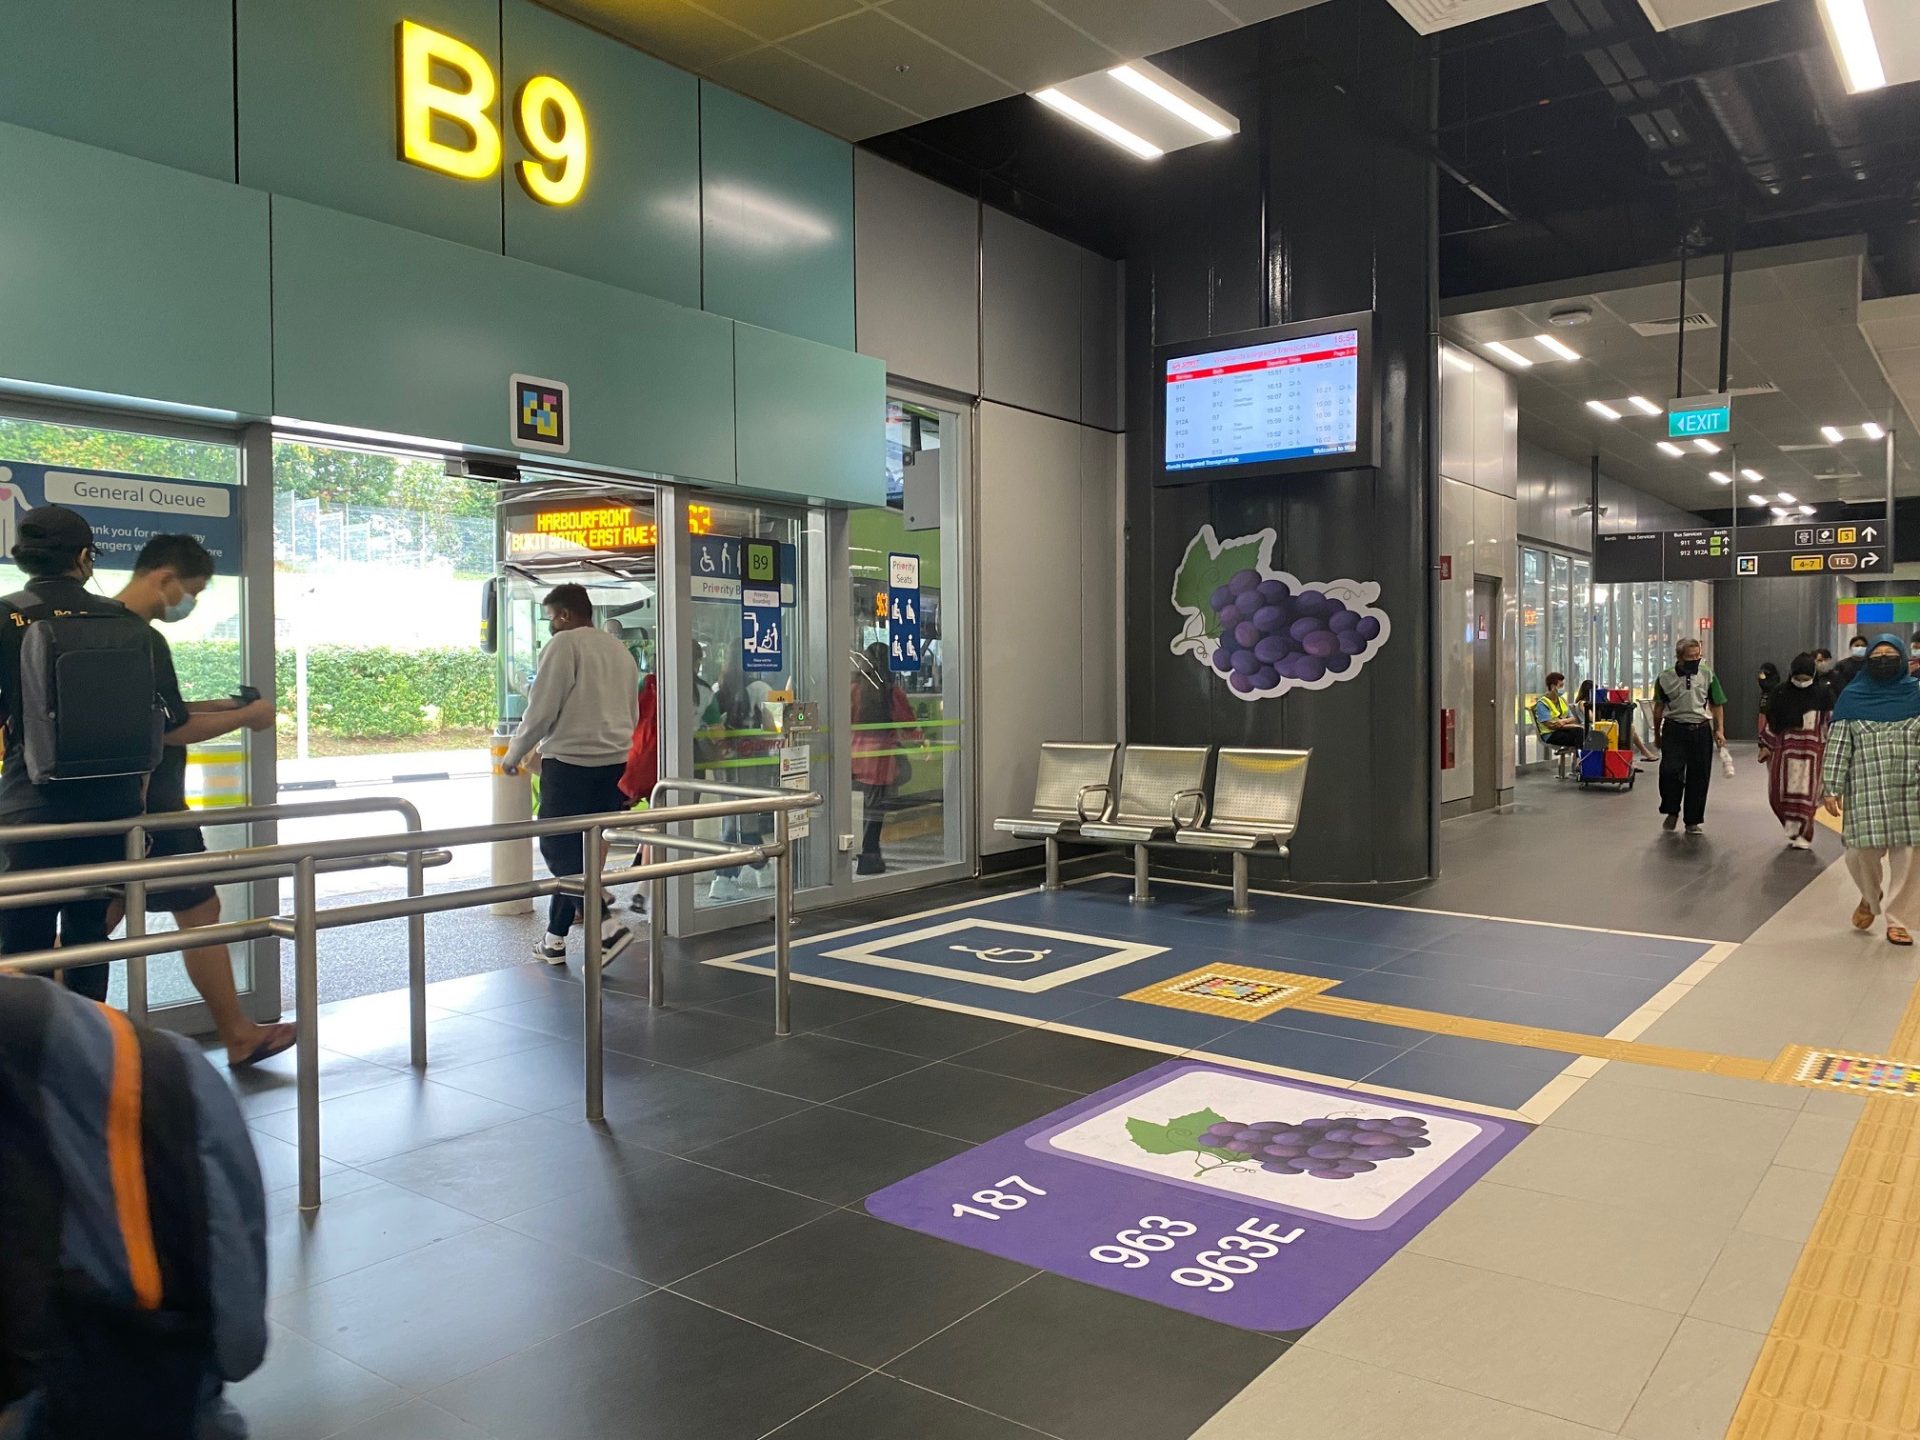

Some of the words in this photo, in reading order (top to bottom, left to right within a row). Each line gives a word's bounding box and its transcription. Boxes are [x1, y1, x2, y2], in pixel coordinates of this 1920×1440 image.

[395, 19, 588, 206] B9
[1686, 413, 1720, 431] EXIT
[74, 481, 144, 502] General
[149, 488, 206, 508] Queue
[537, 508, 632, 532] HARBOURFRONT
[112, 527, 131, 538] you
[134, 527, 149, 537] for
[589, 528, 621, 547] EAST
[623, 527, 649, 545] AVE
[93, 541, 131, 553] engers
[1694, 549, 1708, 557] 912A
[753, 554, 768, 570] B9
[1834, 557, 1851, 565] TEL
[896, 574, 912, 583] Seats
[951, 1175, 1047, 1221] 187
[1089, 1215, 1197, 1269] 963
[1170, 1217, 1305, 1293] 963E
